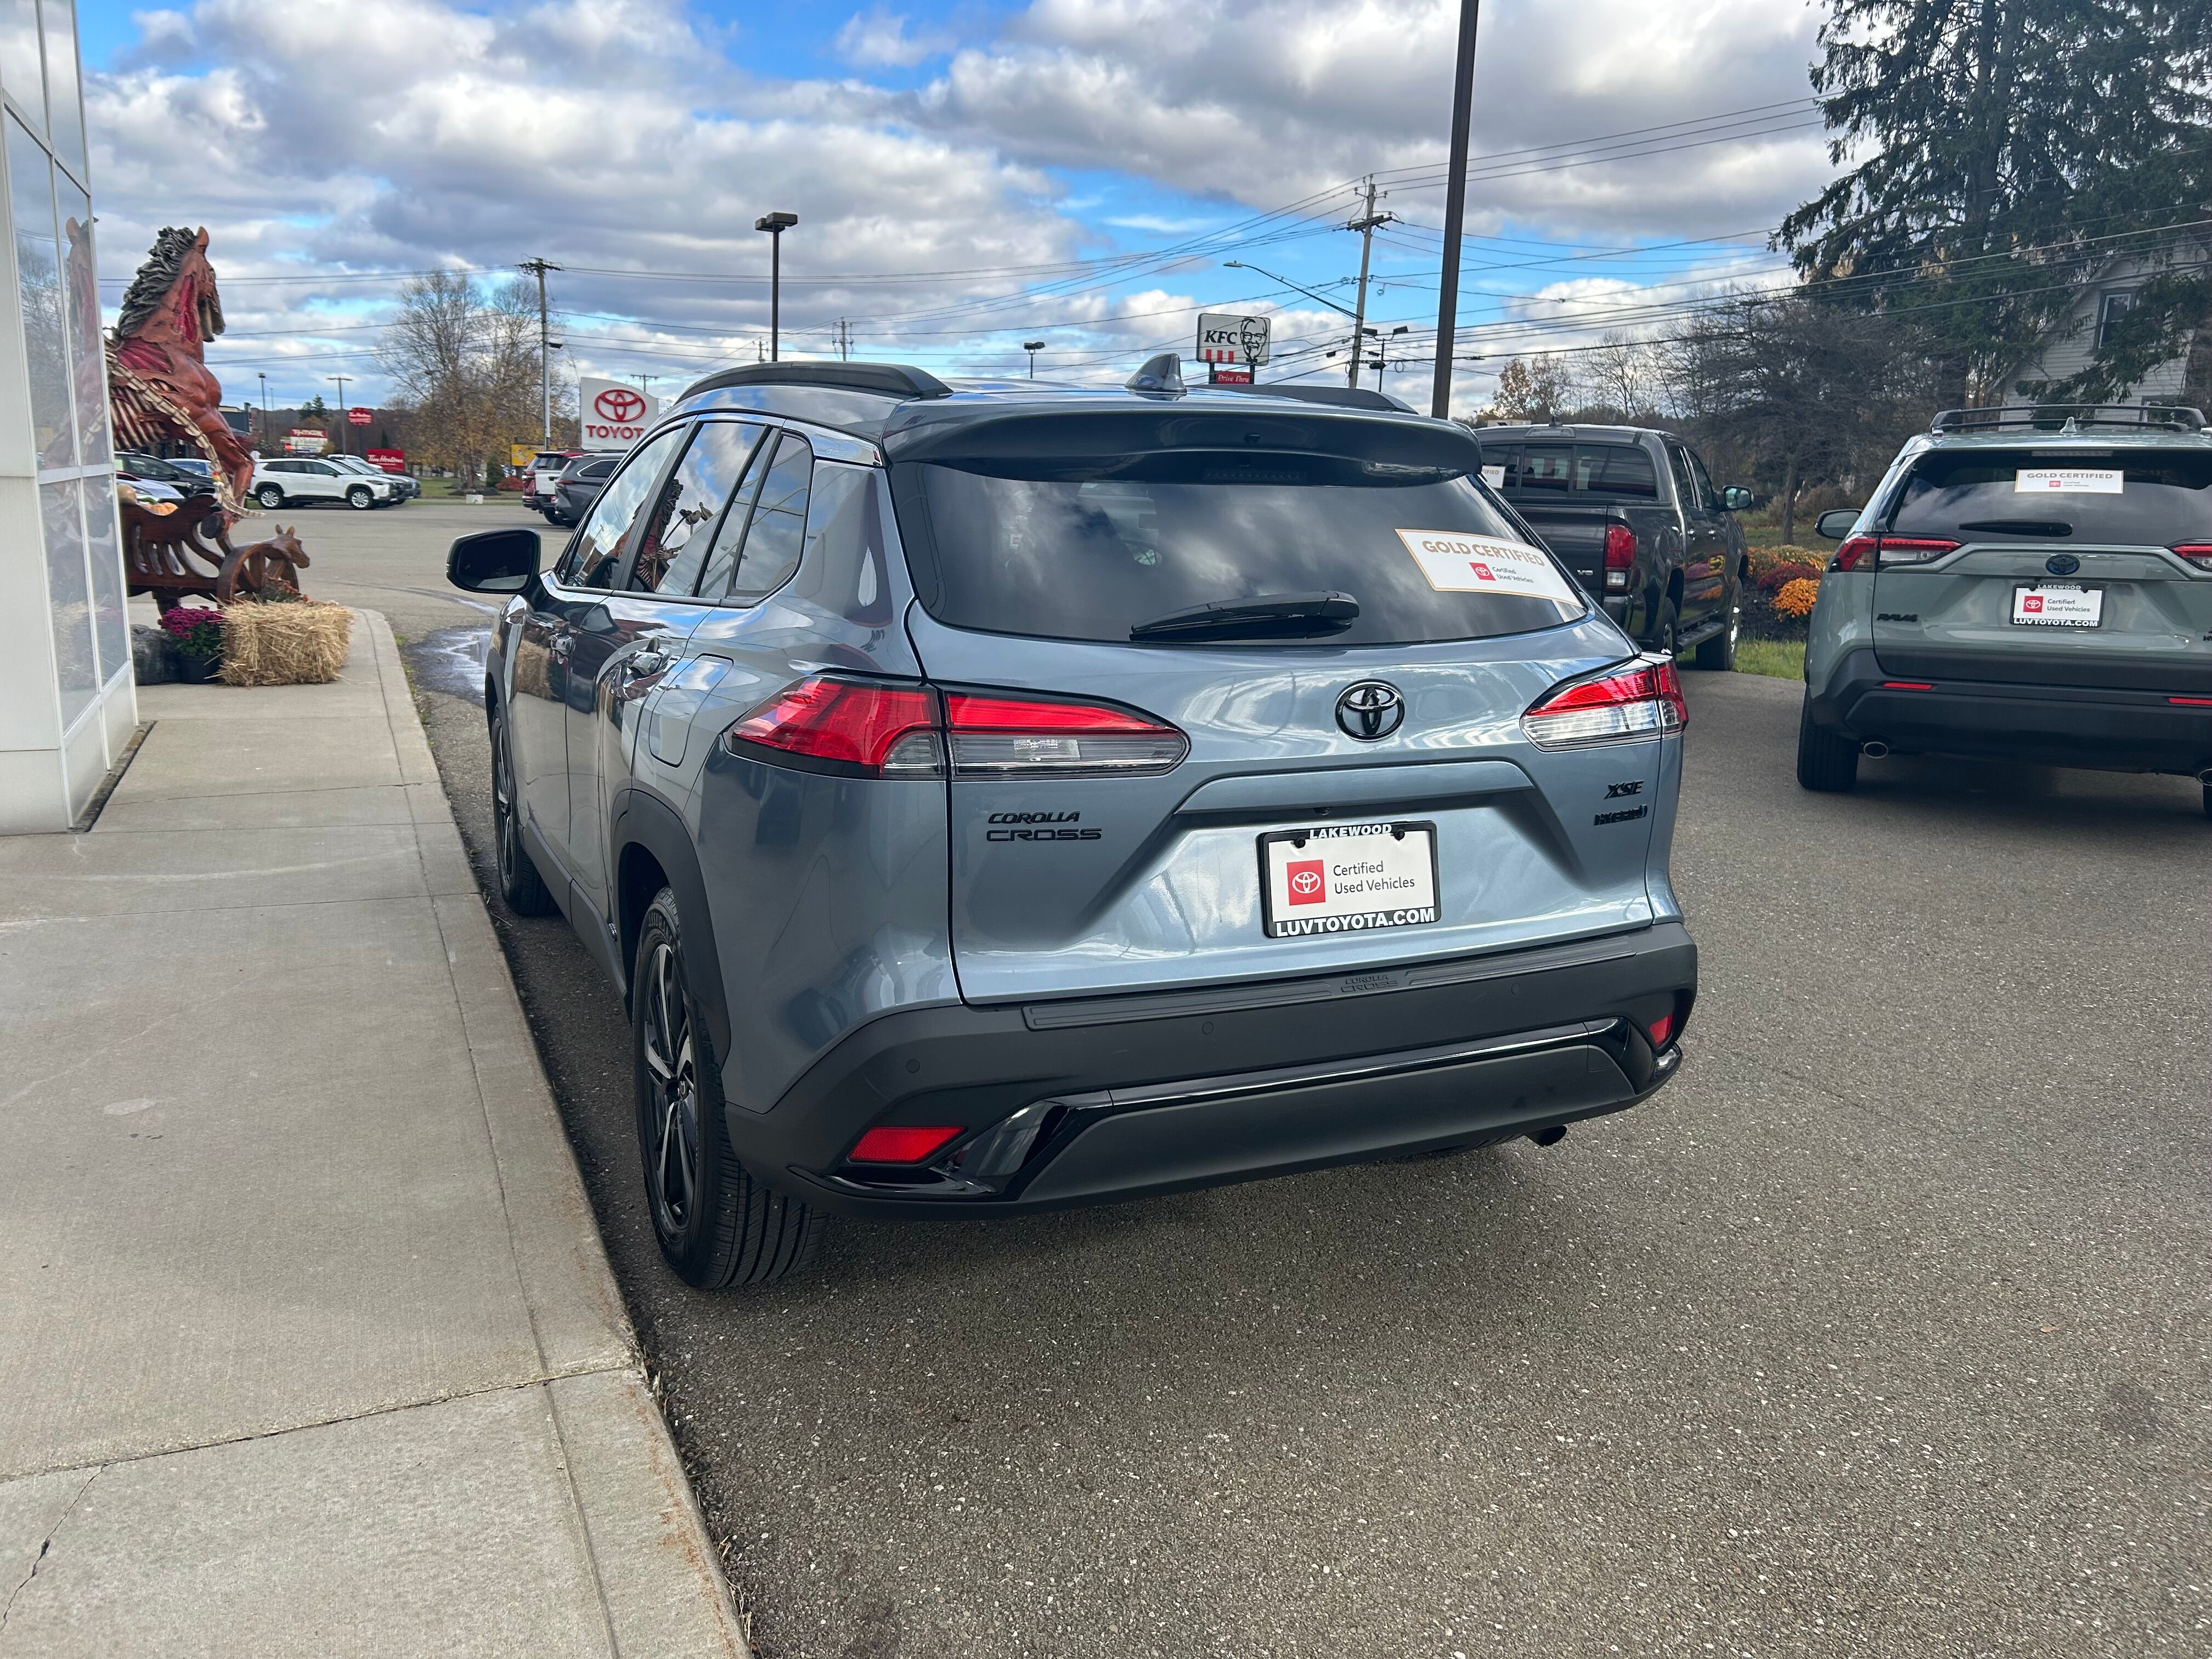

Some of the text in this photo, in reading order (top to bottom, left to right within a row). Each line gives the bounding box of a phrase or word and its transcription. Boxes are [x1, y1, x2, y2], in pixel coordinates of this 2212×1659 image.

[1204, 330, 1238, 345] KFC
[585, 425, 645, 439] TOYOT
[1422, 540, 1545, 567] GOLD CERTIFIED
[1492, 566, 1517, 574] Certified
[2013, 618, 2098, 627] LUVTOYOTA.COM
[1603, 780, 1644, 799] XSE
[988, 811, 1081, 824] COROLLA
[986, 828, 1102, 841] CROSS
[1310, 824, 1392, 839] LAKEWOOD
[1333, 861, 1384, 876] Certified
[1334, 877, 1415, 894] Used Vehicles
[1276, 907, 1435, 937] LUVTOYOTA.COM
[1341, 980, 1398, 992] CROSS
[1345, 974, 1389, 985] COROLLA
